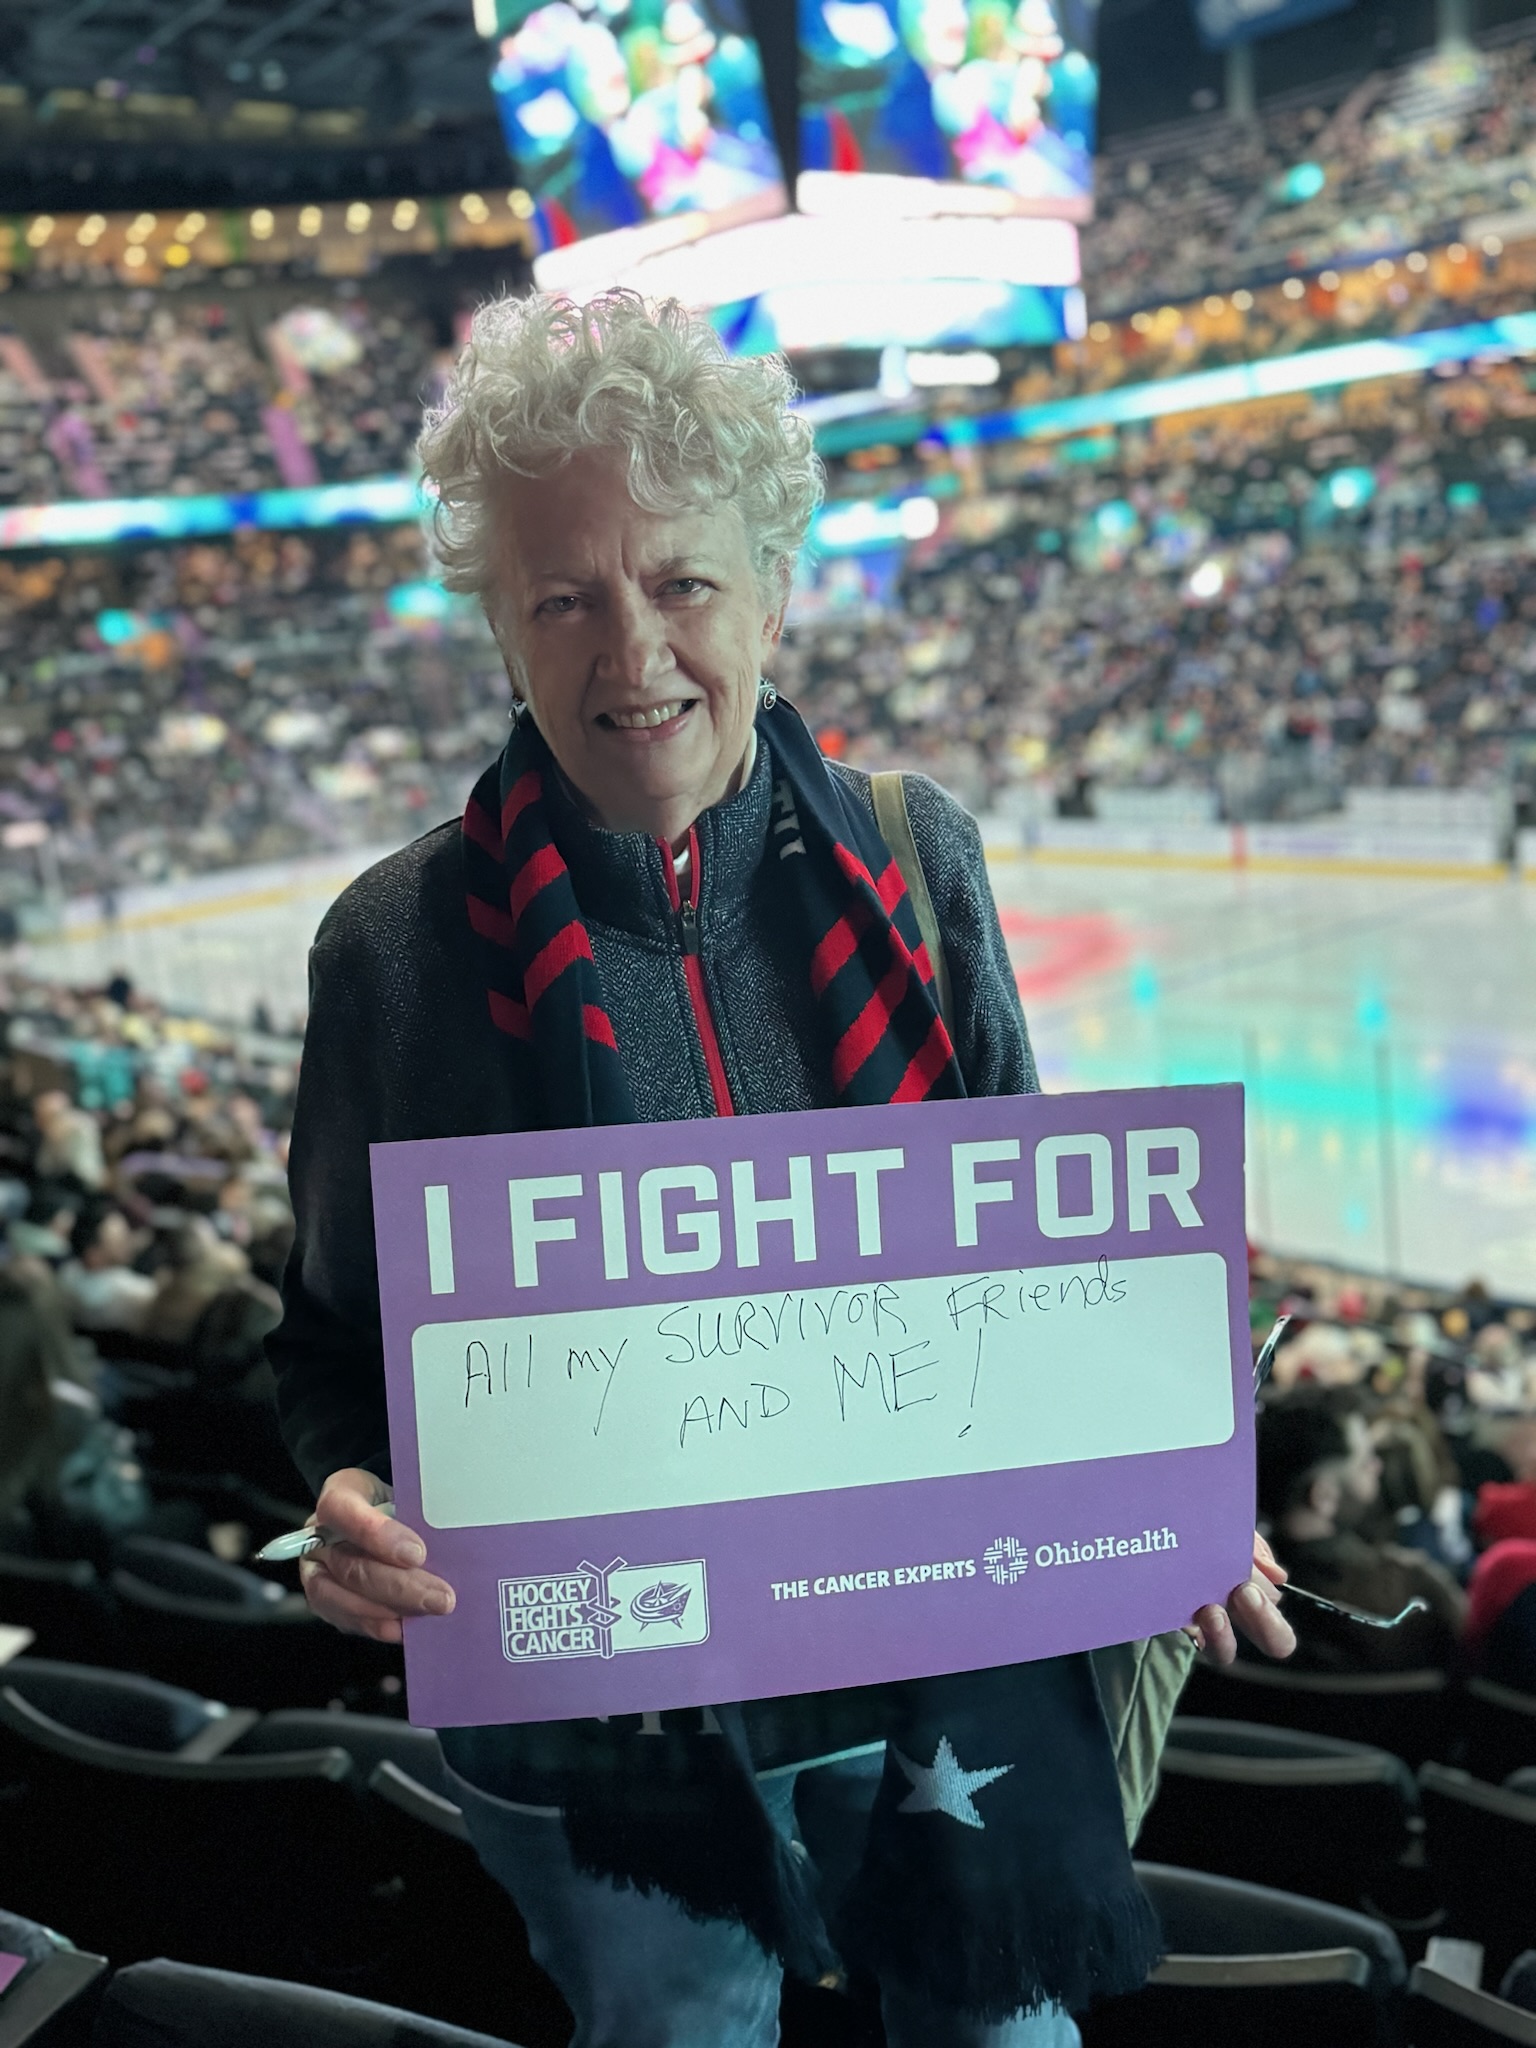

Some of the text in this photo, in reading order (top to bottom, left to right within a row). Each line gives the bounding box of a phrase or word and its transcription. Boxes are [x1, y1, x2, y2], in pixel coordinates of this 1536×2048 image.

[424, 1126, 1205, 1295] I FIGHT FOR
[465, 1334, 533, 1408] All
[567, 1338, 629, 1436] my
[657, 1283, 907, 1364] SURVIVOR
[680, 1383, 791, 1448] AND
[1034, 1527, 1179, 1568] OhioHealth
[508, 1578, 592, 1607] HOCKEY
[771, 1559, 977, 1601] THE CANCER EXPERTS
[510, 1604, 583, 1632] FIGHTS
[510, 1627, 597, 1656] CANCER
